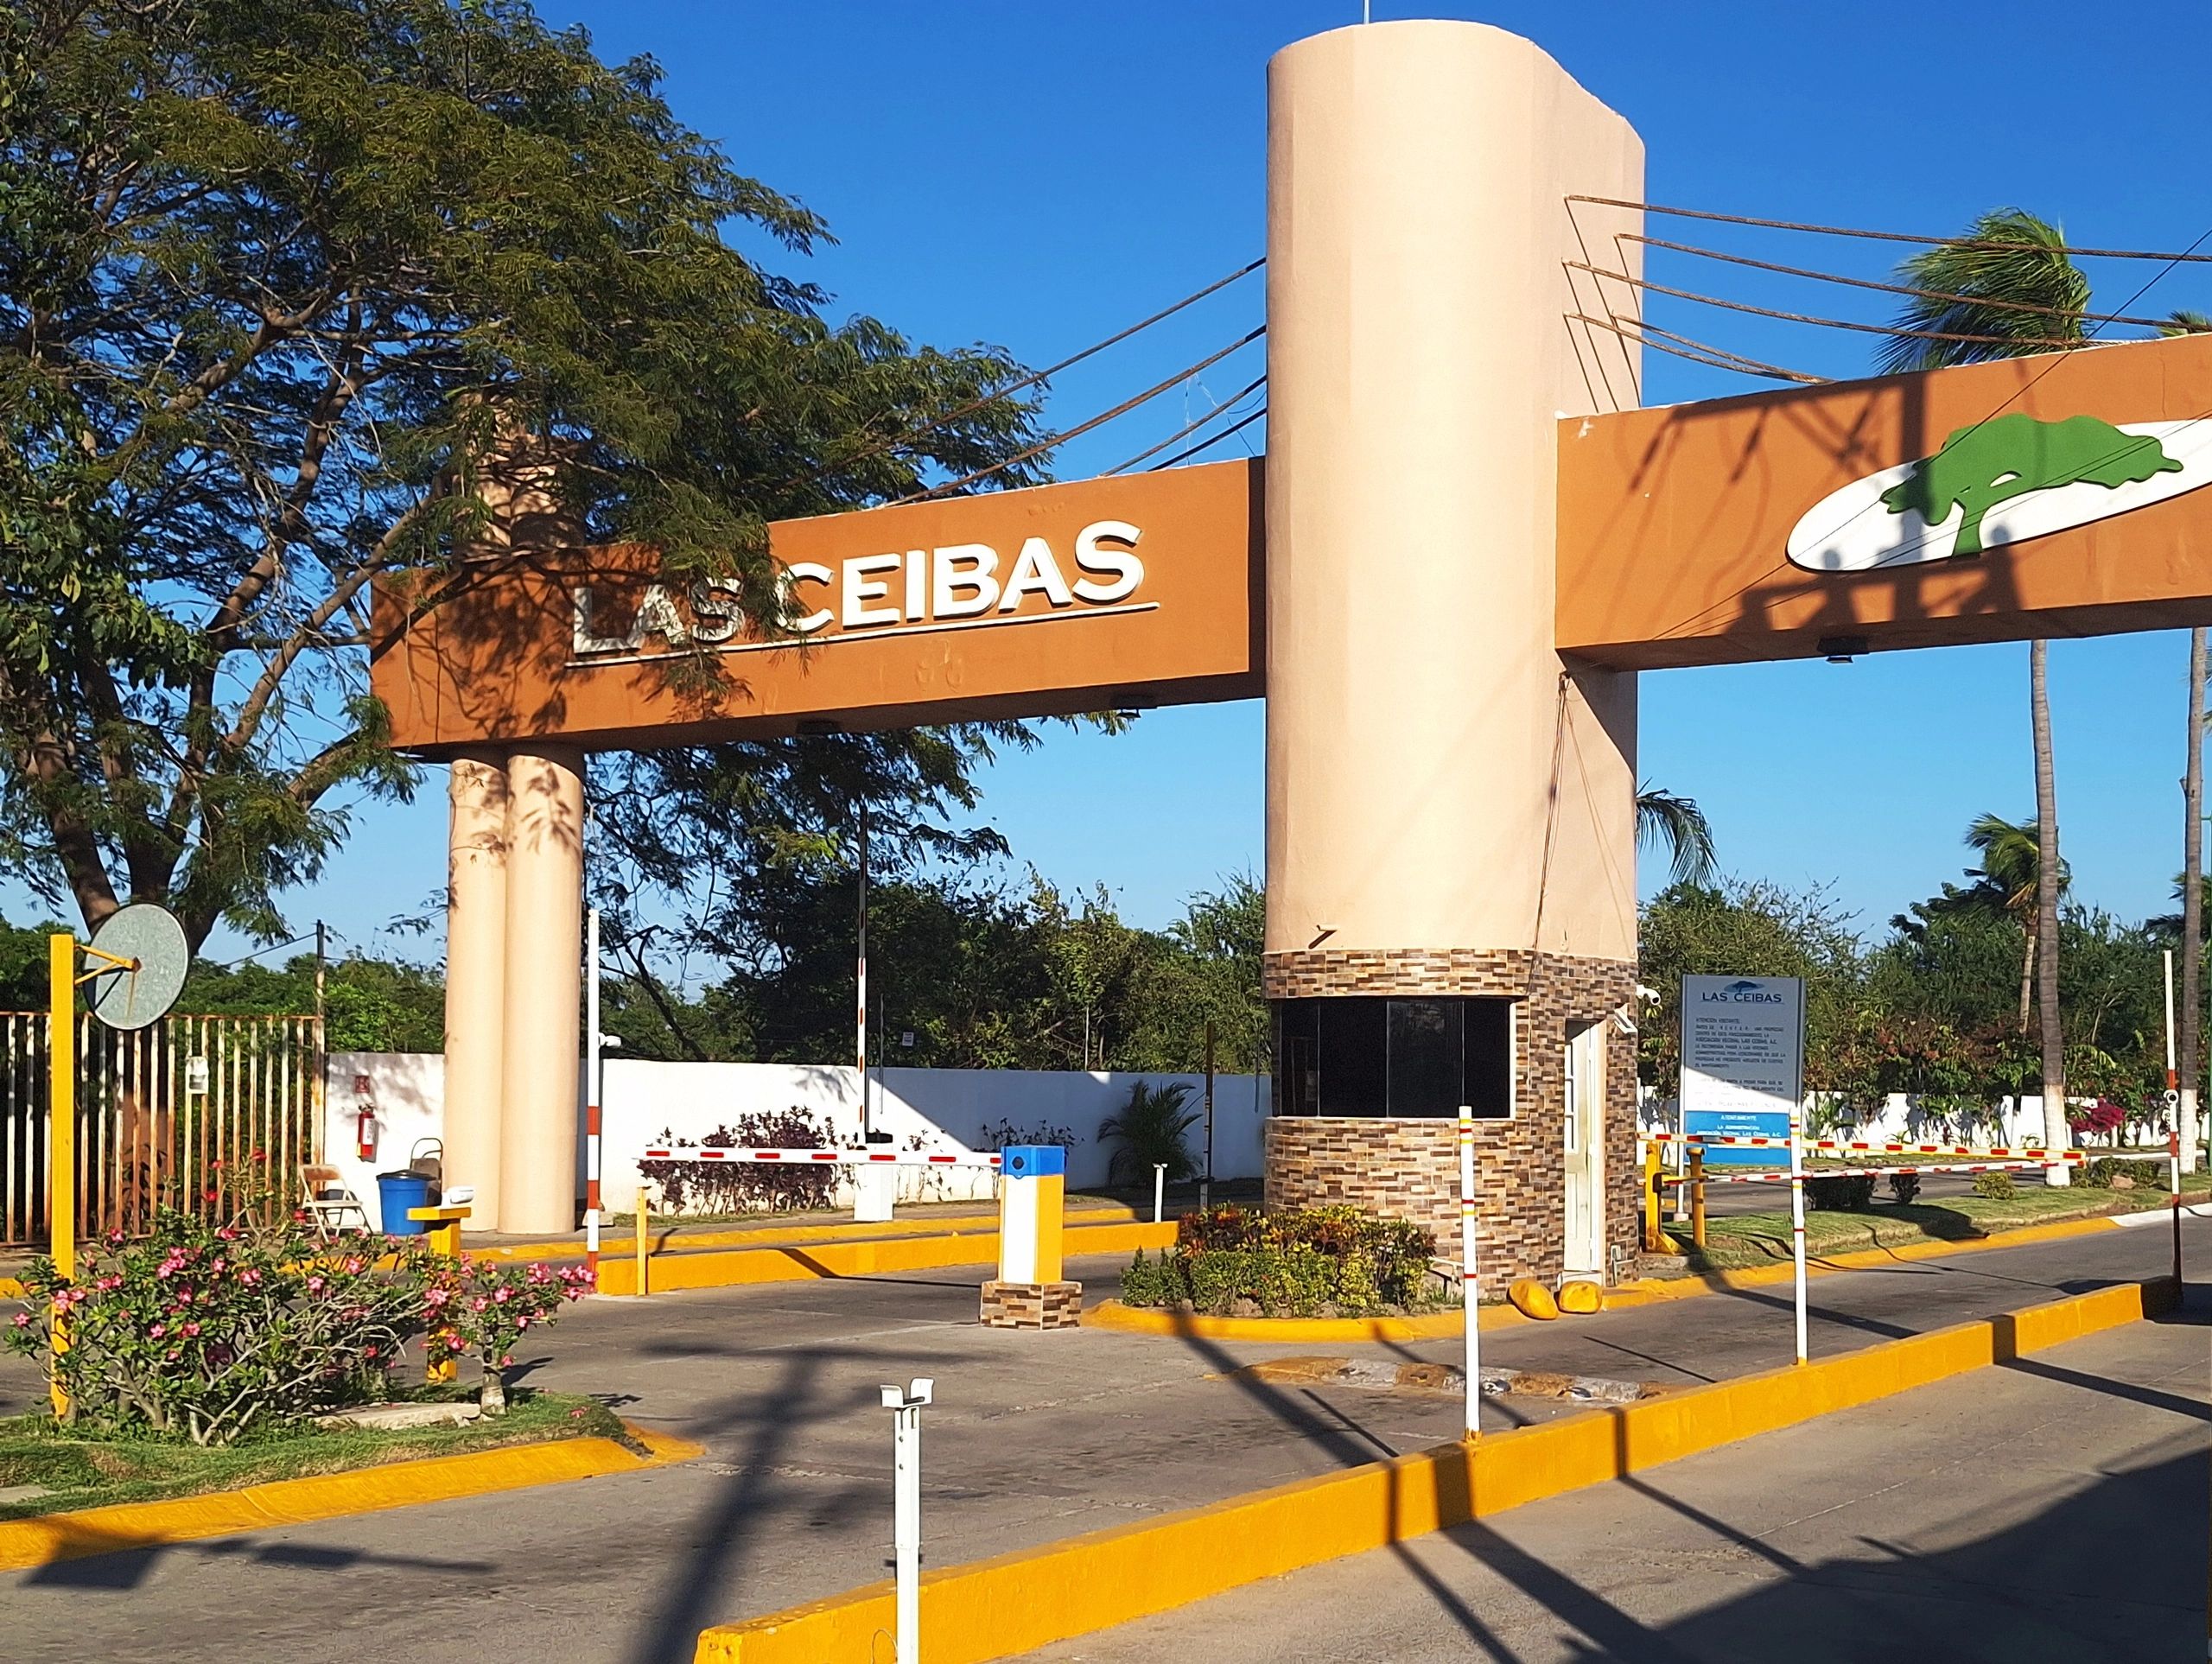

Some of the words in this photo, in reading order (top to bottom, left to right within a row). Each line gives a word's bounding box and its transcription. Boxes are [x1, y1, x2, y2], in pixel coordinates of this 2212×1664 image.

[573, 576, 745, 654] LAS
[774, 520, 1146, 632] CEIBAS
[1702, 992, 1728, 1002] LAS
[1733, 993, 1783, 1003] CEIBAS
